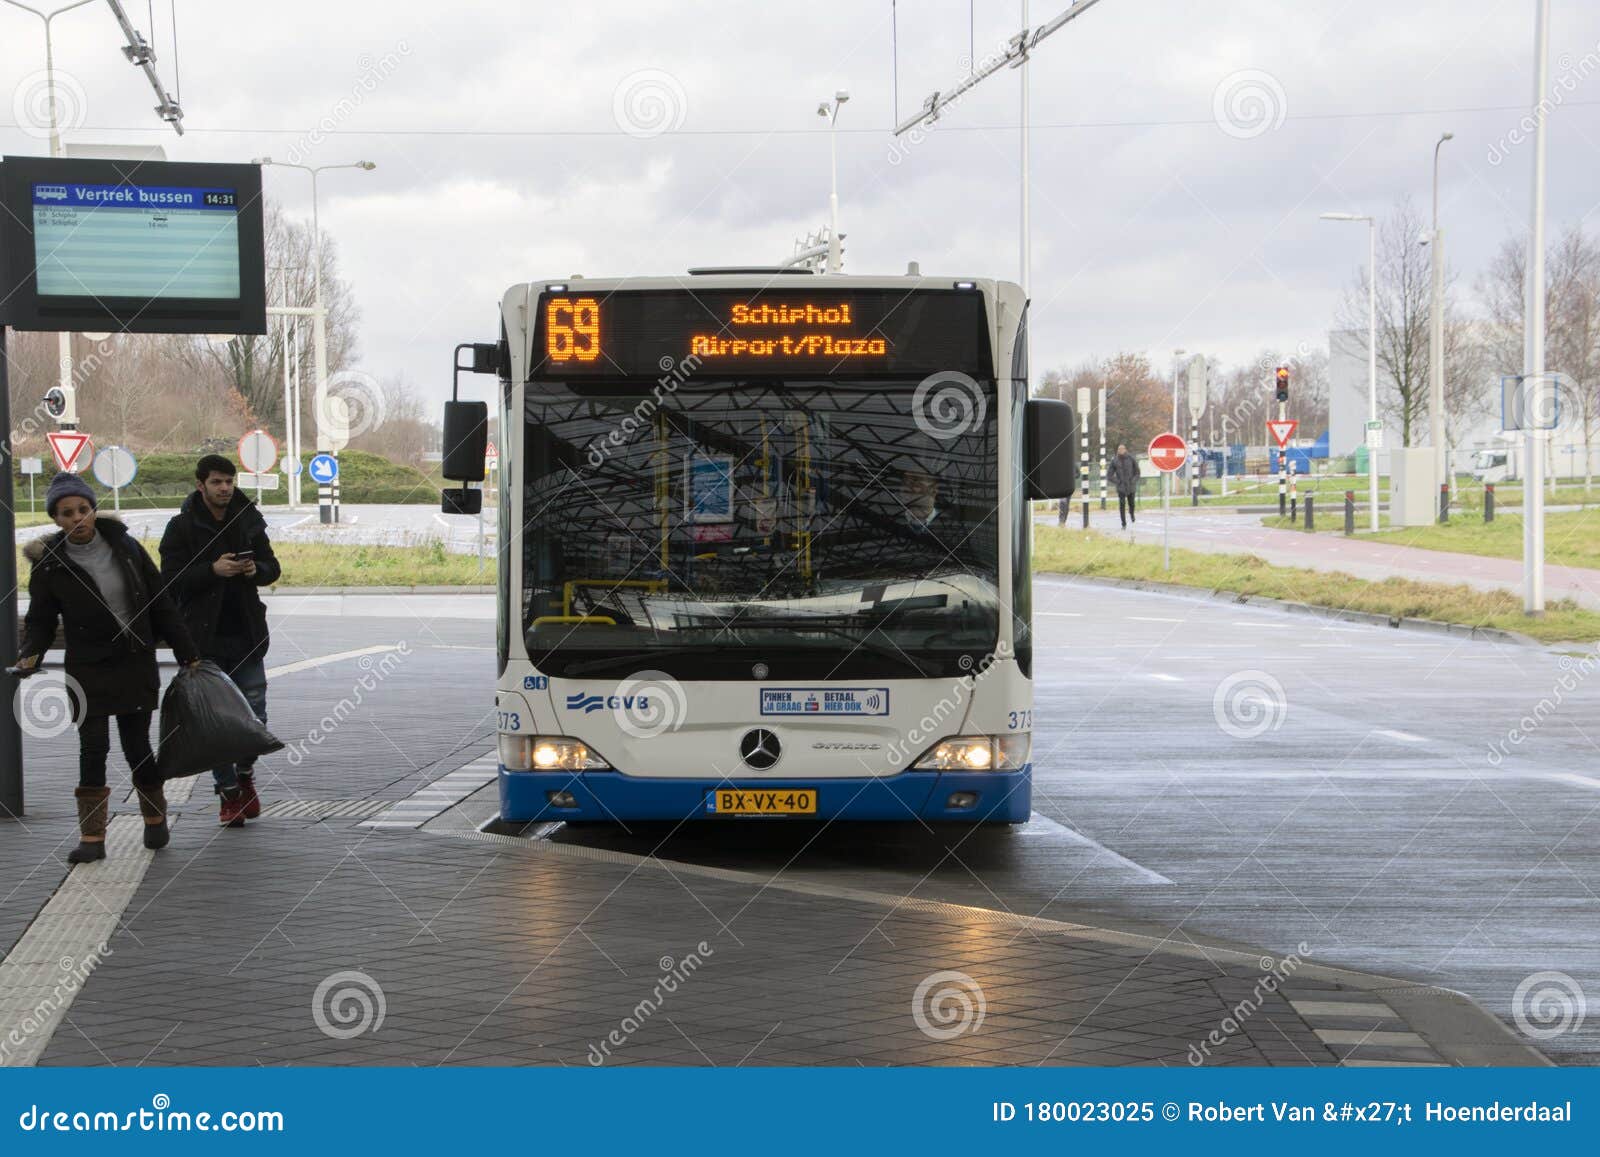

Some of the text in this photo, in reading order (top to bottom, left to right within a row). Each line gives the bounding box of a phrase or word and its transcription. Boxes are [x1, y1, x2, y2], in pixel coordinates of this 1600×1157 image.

[75, 187, 193, 203] Vertrek bussen
[206, 194, 234, 205] 14:31
[732, 304, 851, 323] Schiphol
[548, 299, 599, 360] 69
[692, 335, 886, 355] Airport/Plaza
[607, 695, 649, 710] GVB
[824, 692, 856, 701] BETAAL
[764, 702, 774, 711] JA
[824, 702, 861, 711] HIER OOK
[498, 711, 520, 730] 373
[722, 793, 810, 810] BX-VX-40
